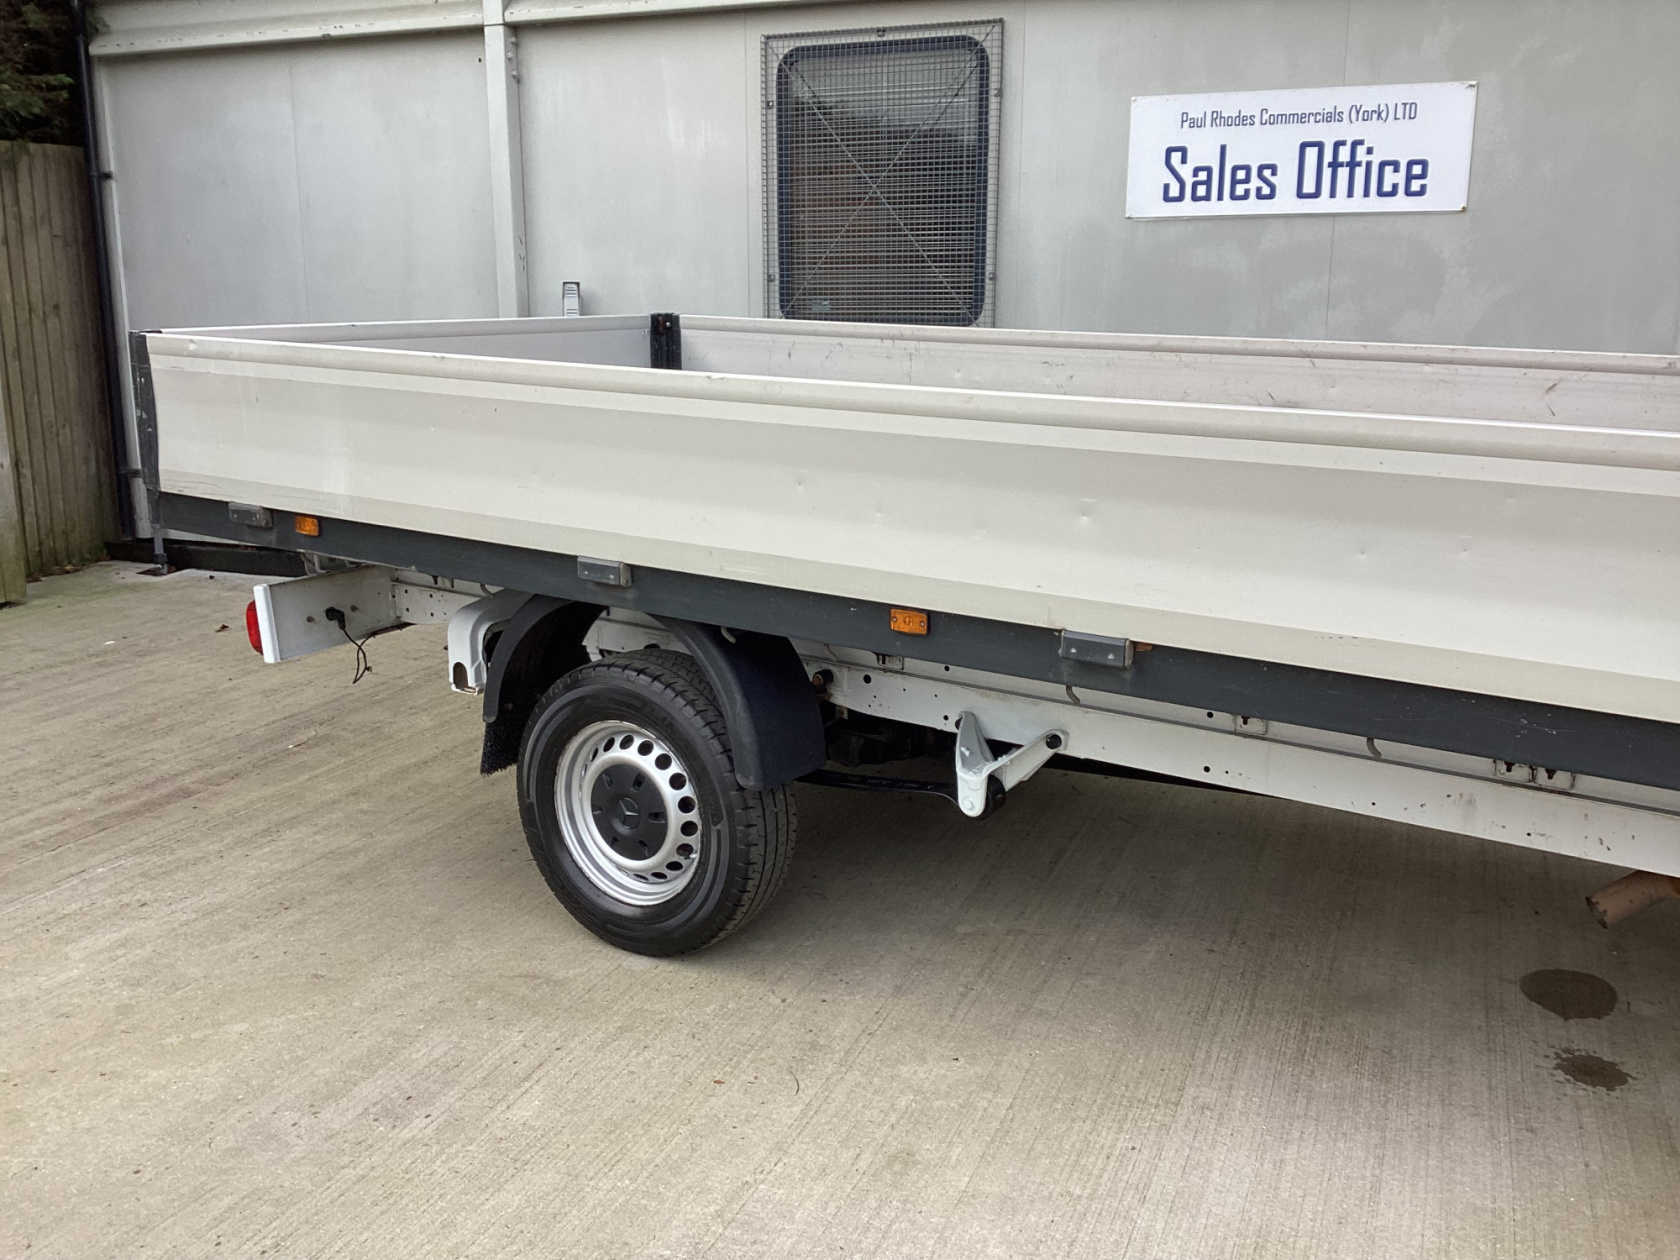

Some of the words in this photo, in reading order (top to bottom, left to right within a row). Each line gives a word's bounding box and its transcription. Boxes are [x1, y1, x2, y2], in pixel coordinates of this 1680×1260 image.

[1180, 111, 1207, 129] Paul
[1210, 109, 1256, 128] Rhodes
[1259, 105, 1344, 126] Commercials
[1348, 103, 1390, 123] (York)
[1393, 102, 1418, 121] LTD
[1162, 144, 1278, 203] Sales
[1295, 139, 1429, 200] Office
